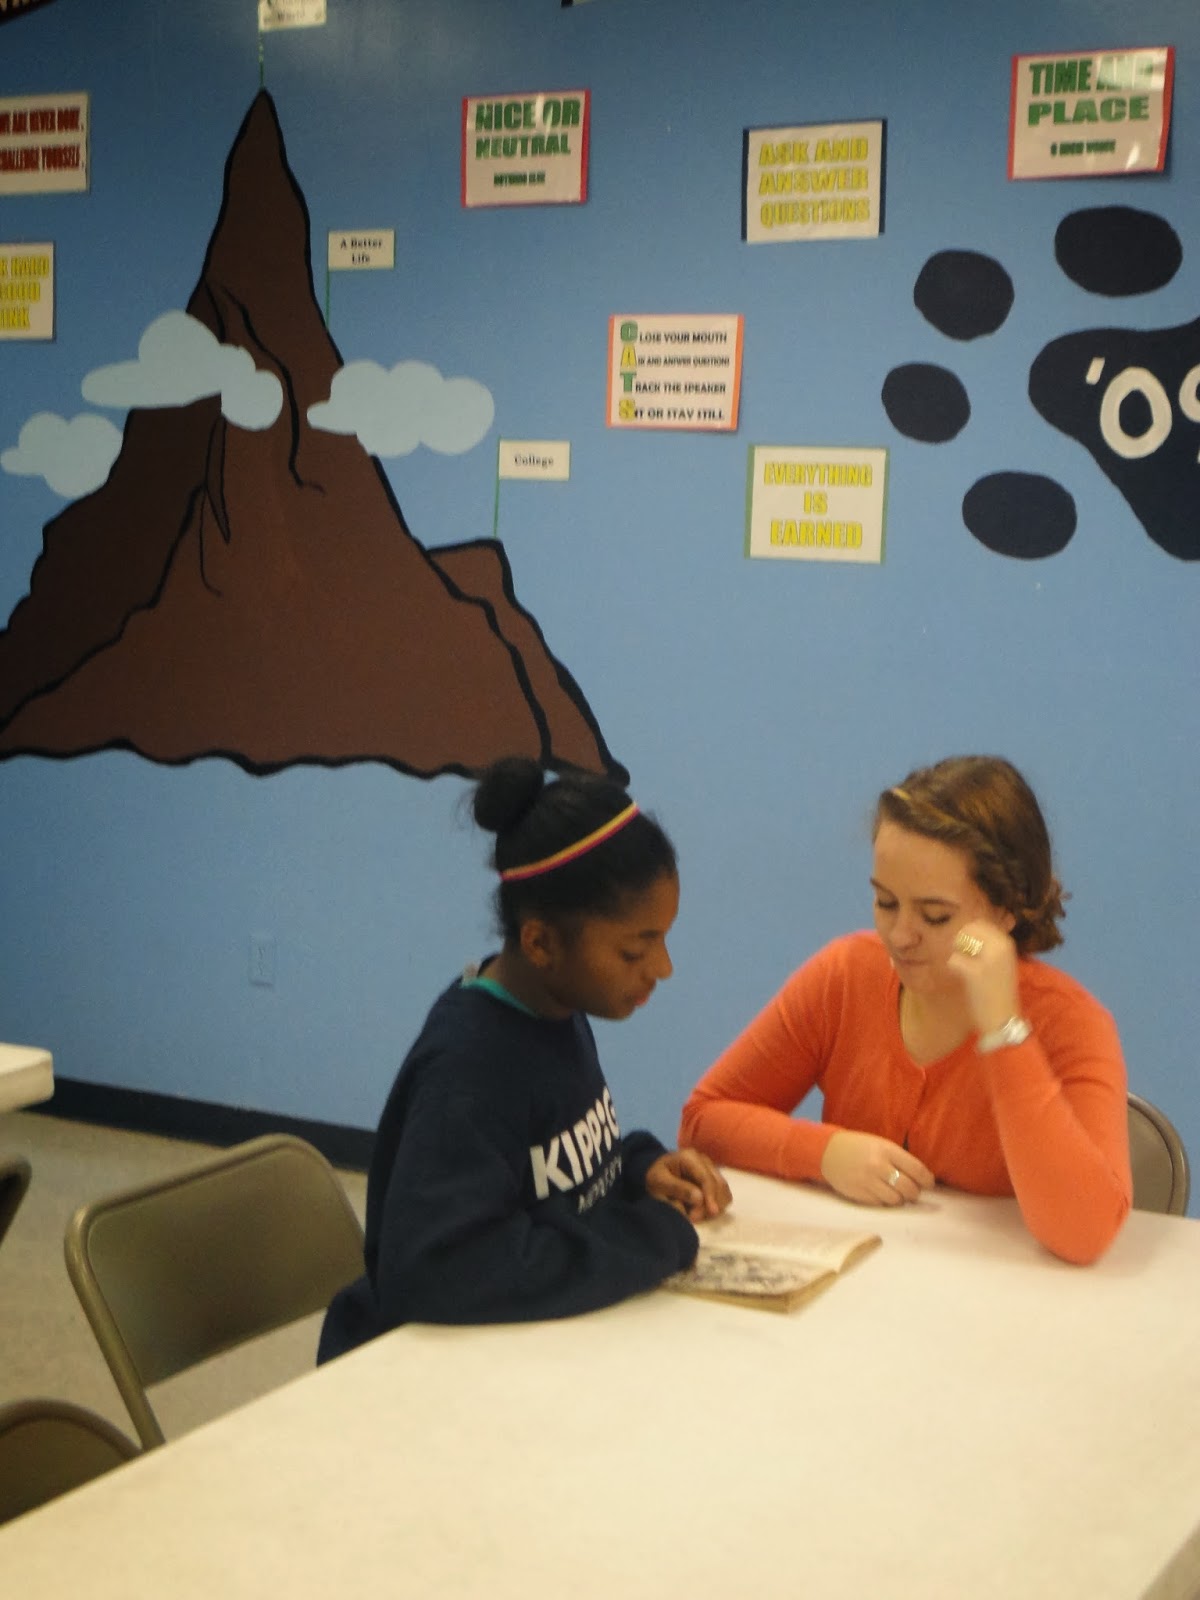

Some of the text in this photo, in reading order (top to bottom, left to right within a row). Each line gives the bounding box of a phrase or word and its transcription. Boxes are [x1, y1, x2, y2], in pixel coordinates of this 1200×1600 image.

[1029, 58, 1093, 95] TIME
[475, 98, 580, 131] NICE OR
[1028, 95, 1150, 127] PLACE
[475, 132, 571, 160] NEUTRAL
[758, 136, 869, 167] ASK AND
[758, 166, 869, 196] ANSWER
[759, 196, 871, 229] QUESTIONS
[340, 237, 383, 250] A Better
[351, 252, 371, 264] Life
[663, 331, 691, 343] YOUR
[692, 331, 728, 343] MOUTH
[663, 381, 682, 394] THE
[646, 406, 664, 420] OR
[666, 406, 695, 420] STAY
[514, 453, 555, 470] College
[763, 461, 874, 488] EVERYTHING
[803, 490, 828, 516] IS
[769, 519, 863, 550] EARNED
